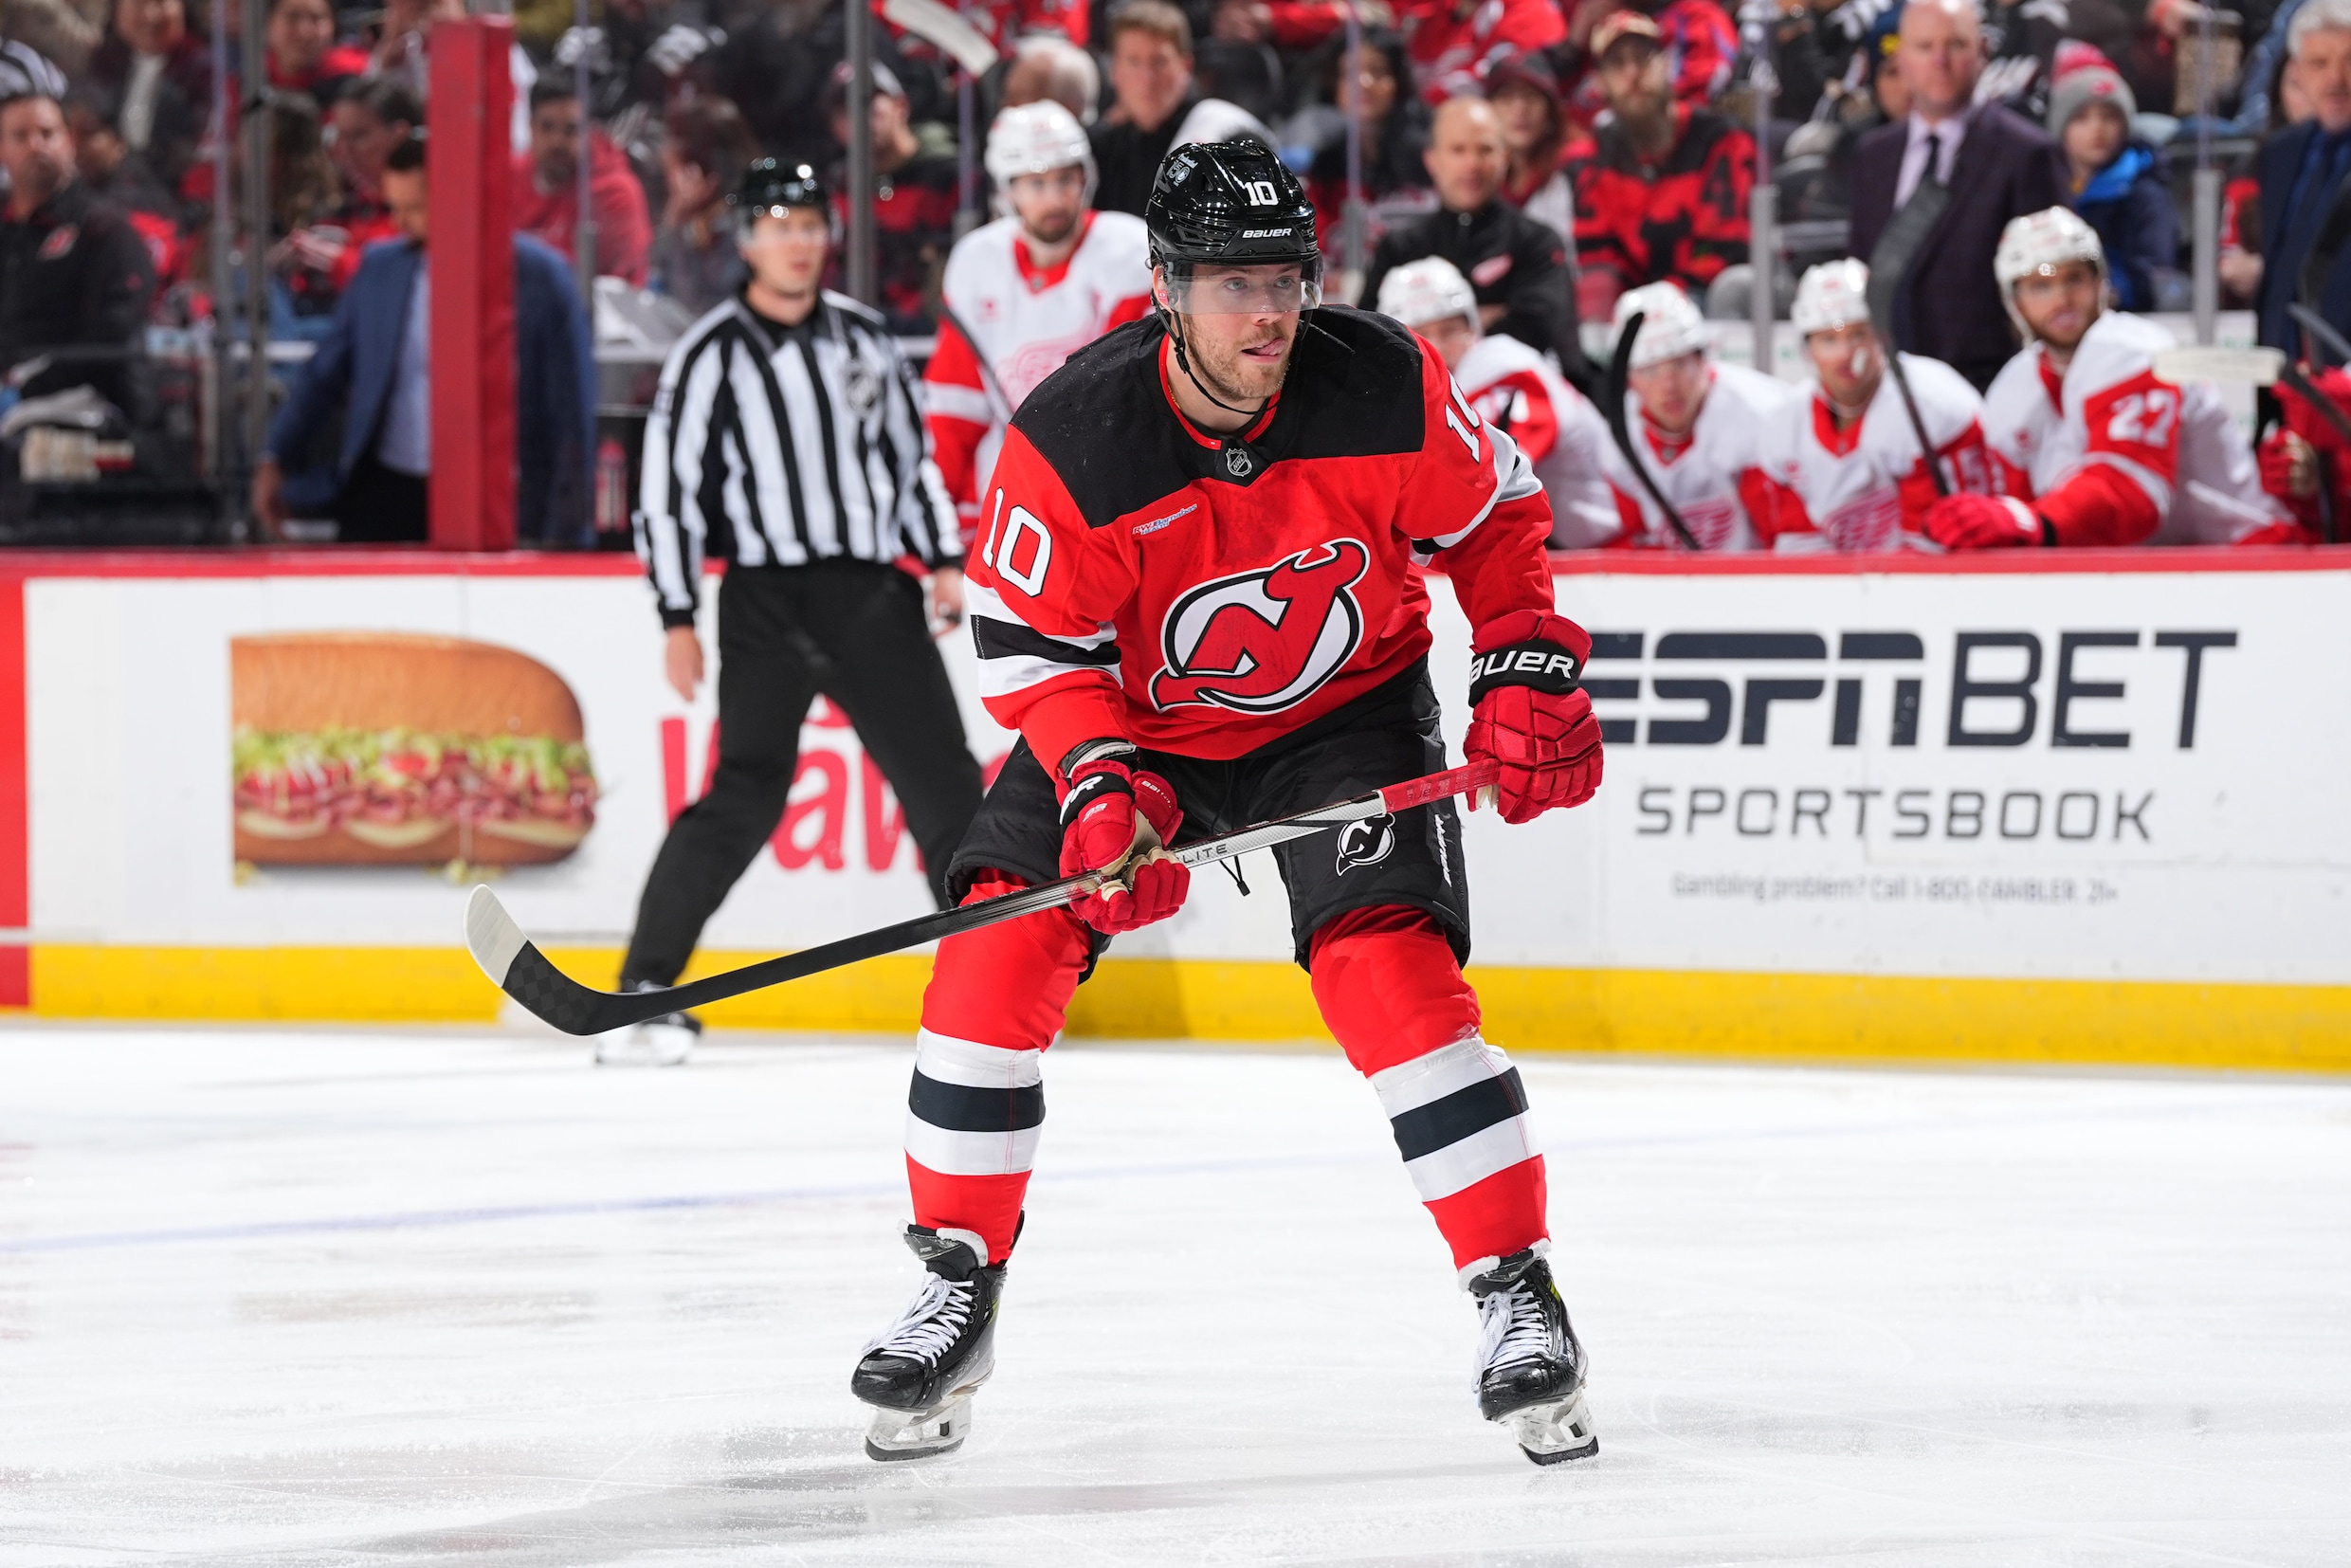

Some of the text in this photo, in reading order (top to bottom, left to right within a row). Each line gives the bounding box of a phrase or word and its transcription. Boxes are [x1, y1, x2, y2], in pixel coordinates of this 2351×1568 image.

[1244, 180, 1279, 206] 10
[1242, 228, 1292, 239] BAUER
[2107, 388, 2178, 448] 27
[1232, 455, 1245, 471] NHL
[981, 486, 1053, 598] 10
[1468, 650, 1575, 686] AUER
[1576, 632, 2237, 748] ESPN BET
[1636, 786, 2154, 842] SPORTSBOOK
[1178, 843, 1228, 864] LITE
[1672, 872, 1765, 904] Gambling
[1870, 874, 1906, 900] Call
